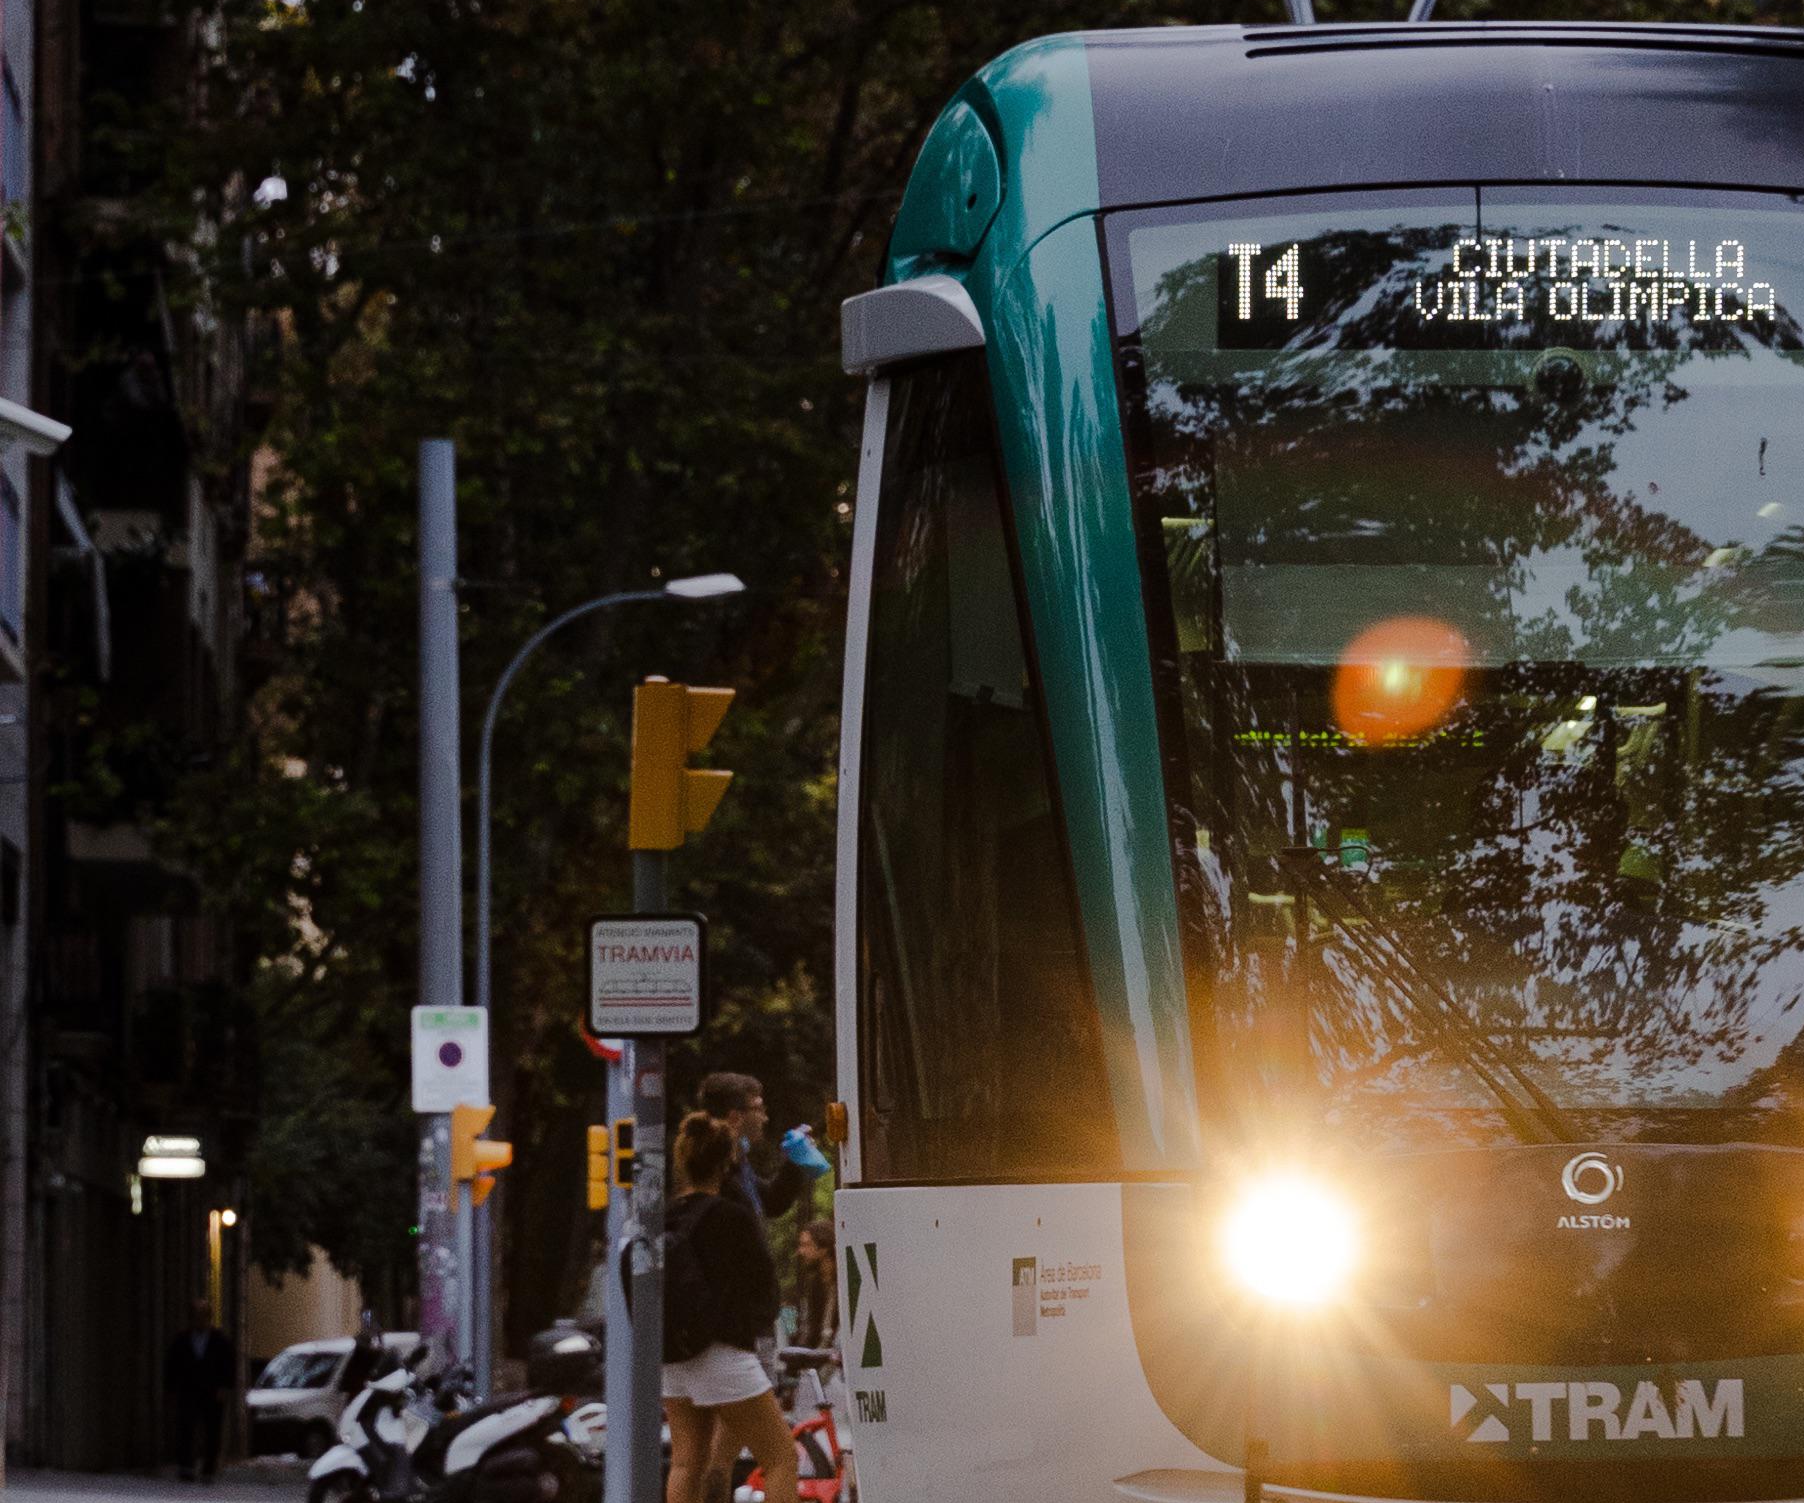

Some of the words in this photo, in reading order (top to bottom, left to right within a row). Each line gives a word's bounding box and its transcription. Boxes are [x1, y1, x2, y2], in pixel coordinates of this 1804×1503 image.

[1452, 239, 1744, 278] CIUTADELLA
[1228, 243, 1304, 320] T4
[1415, 282, 1524, 321] VILA
[1548, 282, 1775, 321] OLIMPICA
[598, 943, 694, 963] TRAMVIA
[1556, 1214, 1631, 1229] ALSTOM
[855, 1390, 887, 1423] TRAM
[1515, 1378, 1745, 1442] TRAM
